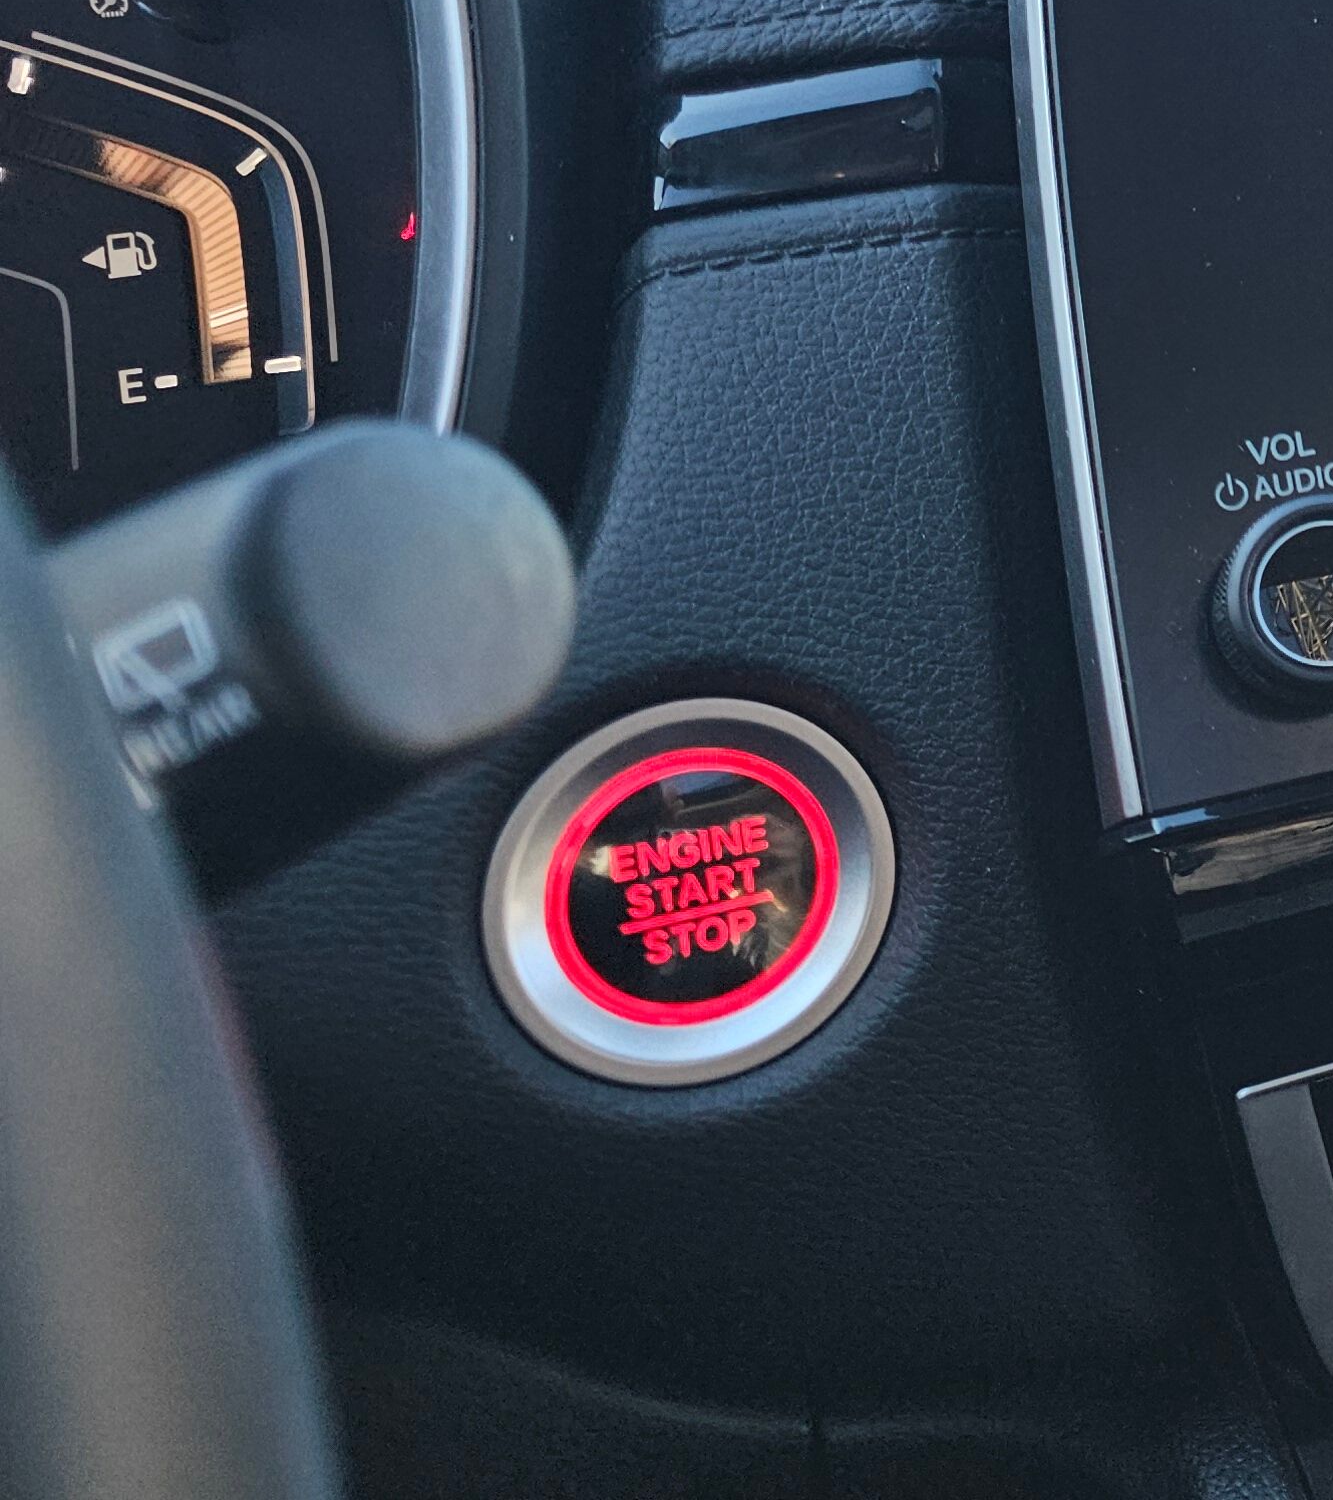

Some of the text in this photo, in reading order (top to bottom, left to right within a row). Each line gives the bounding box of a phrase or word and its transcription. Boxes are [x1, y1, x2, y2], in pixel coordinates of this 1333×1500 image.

[118, 367, 147, 405] E
[1245, 430, 1317, 465] VOL
[608, 815, 770, 884] ENGINE
[625, 857, 762, 920] START
[643, 908, 757, 965] STOP
